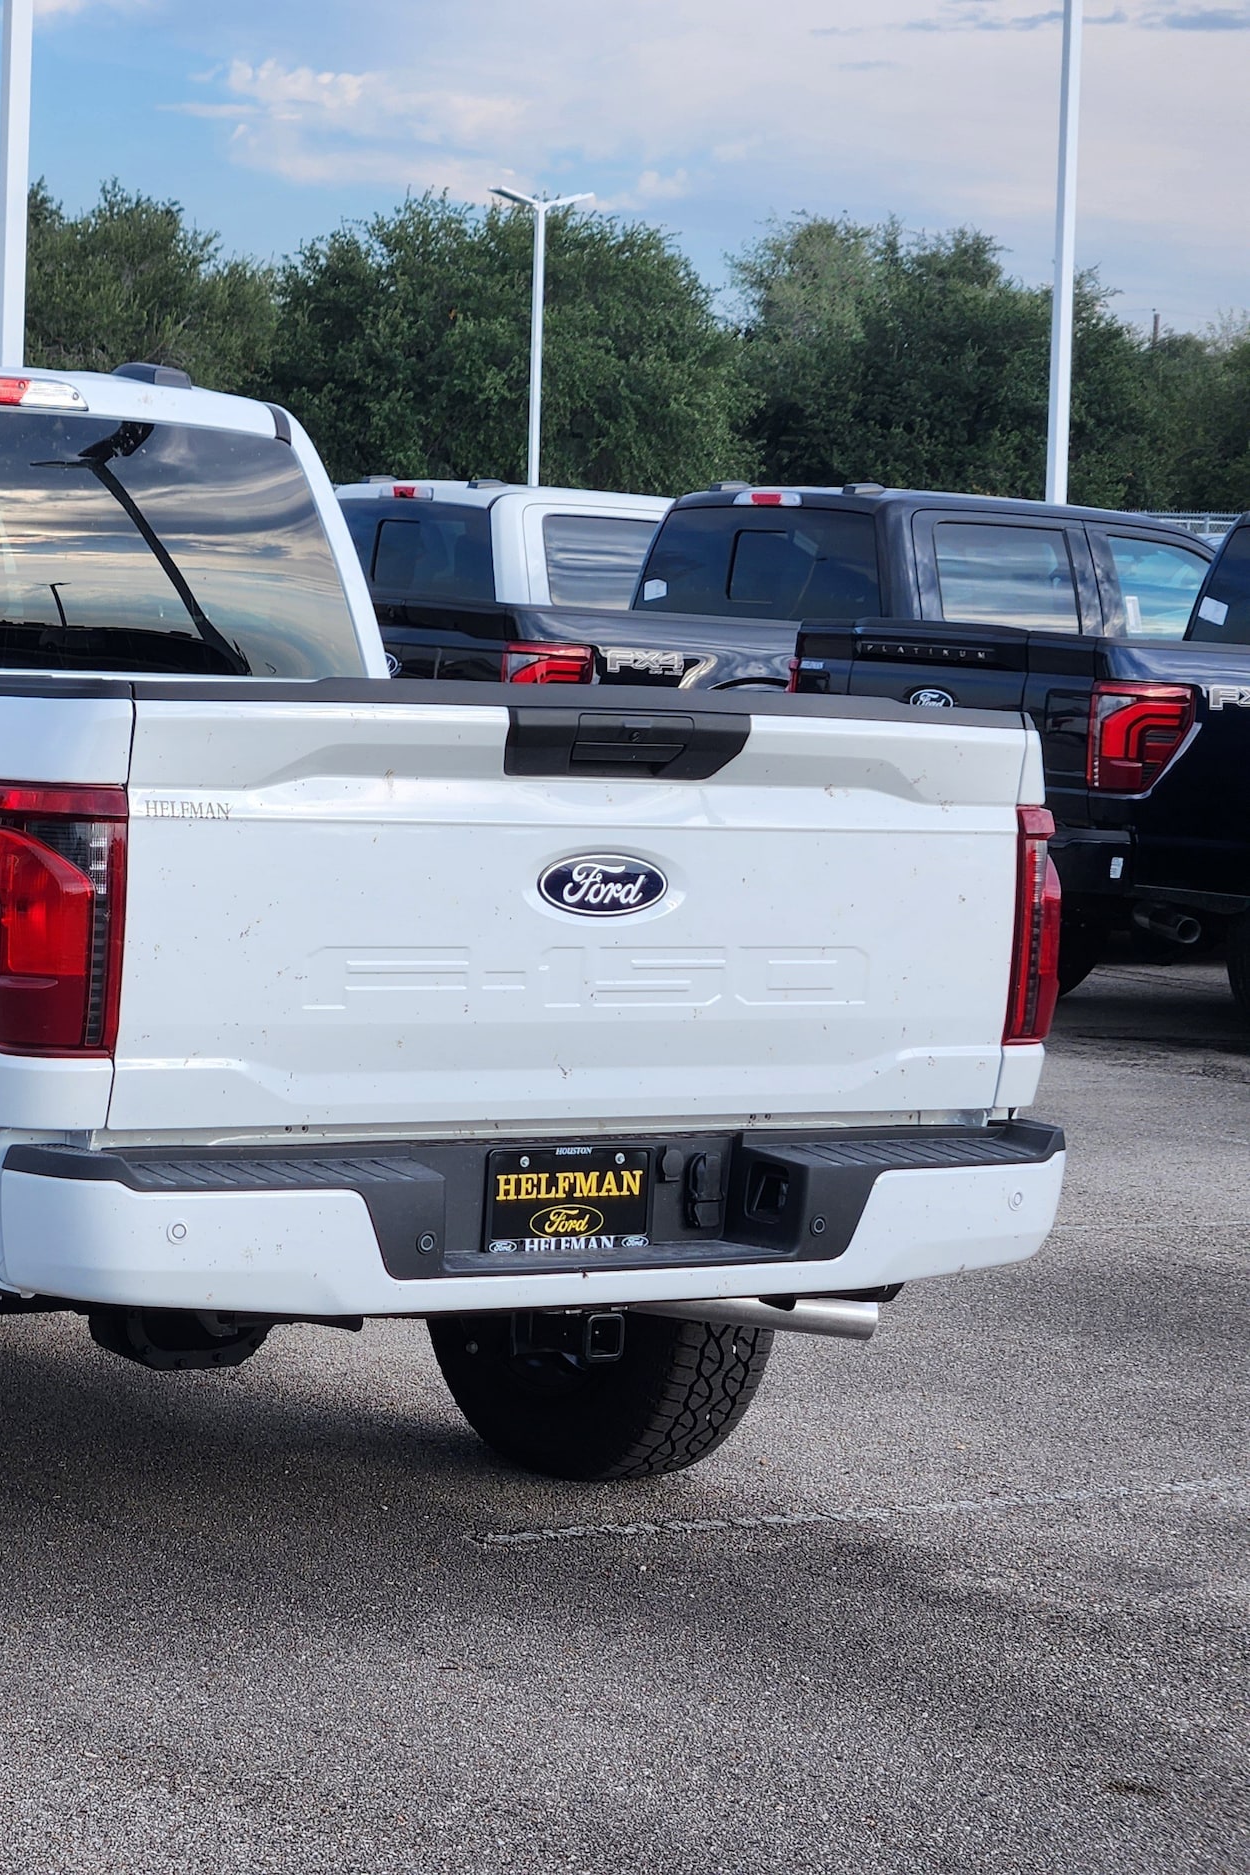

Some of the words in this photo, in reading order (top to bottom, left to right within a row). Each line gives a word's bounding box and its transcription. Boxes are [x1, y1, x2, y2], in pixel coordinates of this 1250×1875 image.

[606, 650, 684, 673] FX4
[866, 644, 986, 660] PLATINUM
[916, 692, 946, 707] Ford
[144, 799, 230, 820] HELFMAN
[562, 862, 647, 905] Ford
[555, 1147, 593, 1155] HOUSTON
[496, 1170, 644, 1201] HELFMAN
[544, 1208, 590, 1233] Ford
